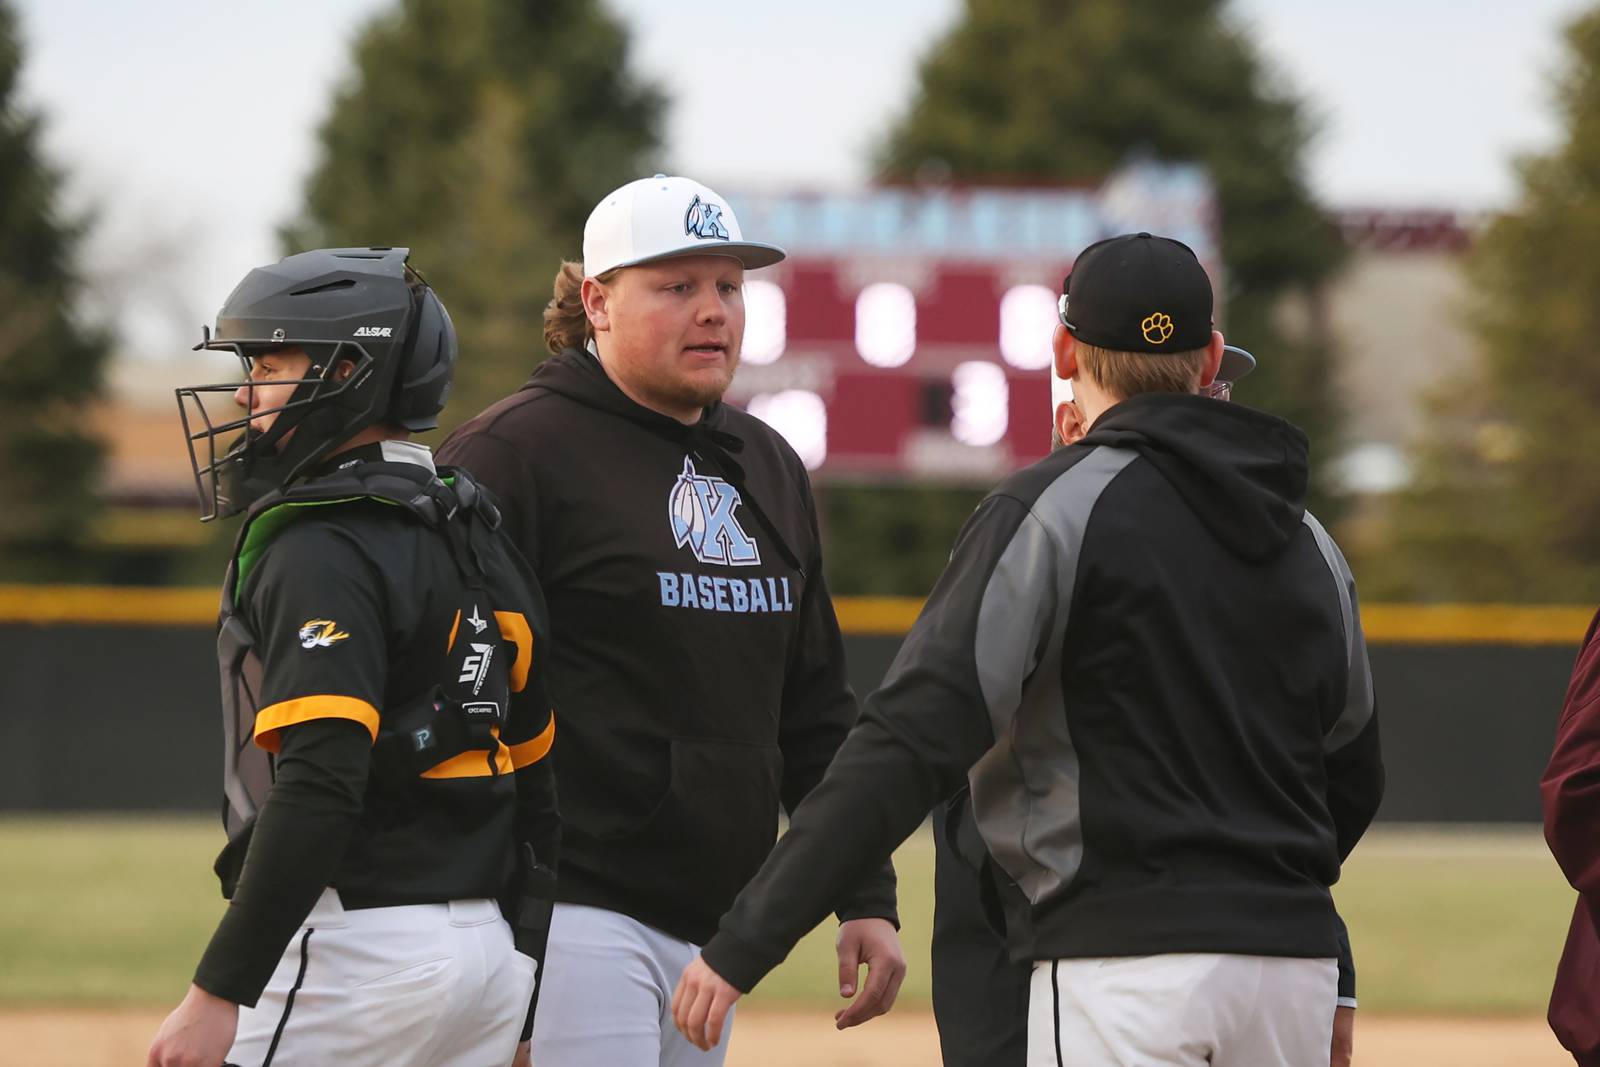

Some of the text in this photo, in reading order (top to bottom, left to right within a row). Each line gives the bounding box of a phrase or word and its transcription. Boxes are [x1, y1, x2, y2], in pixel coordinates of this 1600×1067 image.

[697, 203, 729, 241] K
[691, 475, 762, 567] K
[656, 572, 793, 613] BASEBALL
